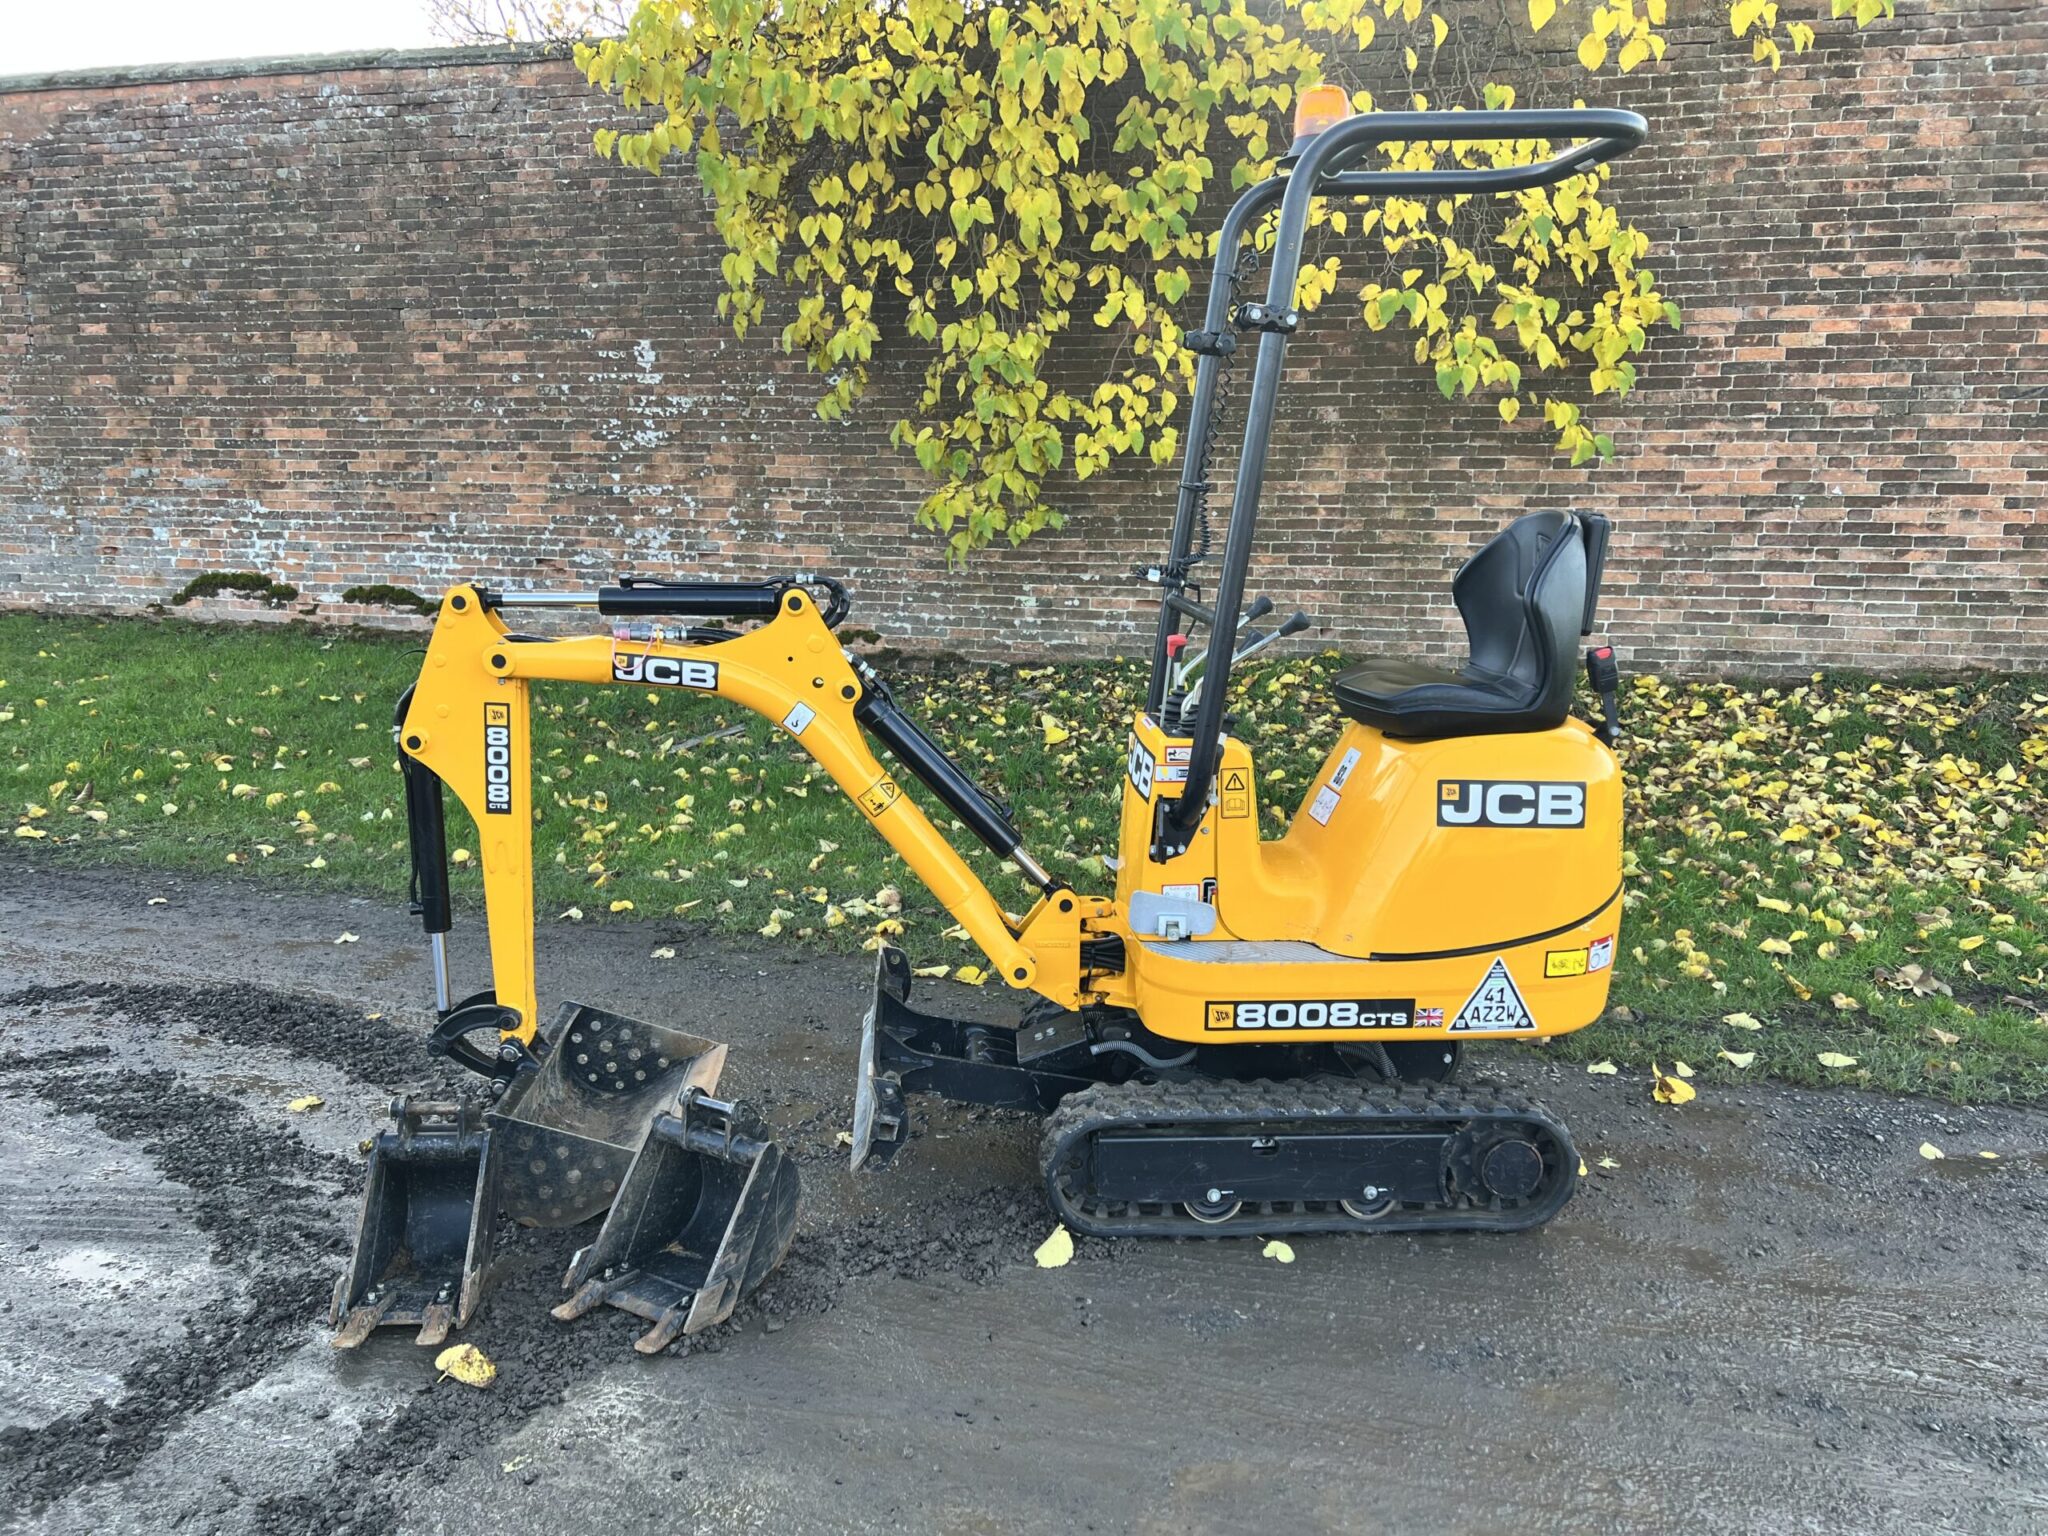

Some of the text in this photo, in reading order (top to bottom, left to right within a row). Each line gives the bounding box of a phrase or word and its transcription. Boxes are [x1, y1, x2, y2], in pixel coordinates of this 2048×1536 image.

[615, 656, 716, 689] JCB
[487, 727, 510, 803] 8008
[1441, 783, 1584, 825] JCB
[1484, 987, 1506, 1004] 41
[1215, 1010, 1230, 1021] JCB
[1470, 1005, 1517, 1023] AZ2W
